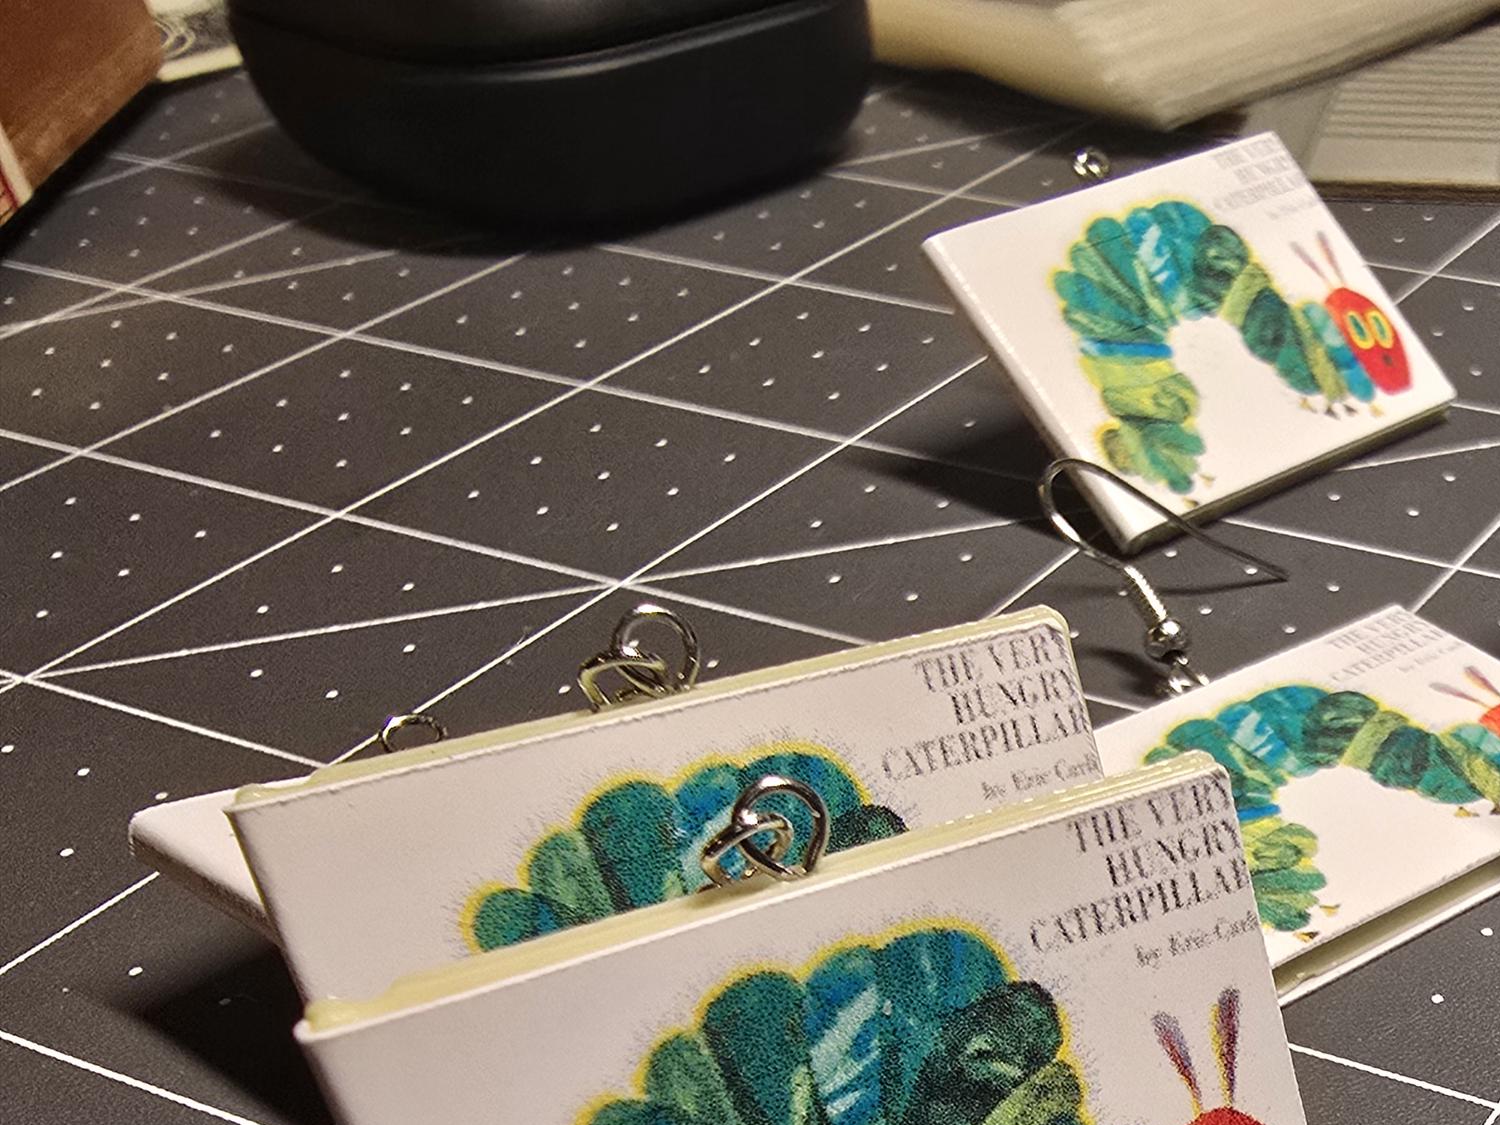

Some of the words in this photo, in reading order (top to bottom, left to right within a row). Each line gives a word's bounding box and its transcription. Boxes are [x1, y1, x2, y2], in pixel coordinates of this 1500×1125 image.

[914, 647, 983, 692] THE
[988, 628, 1069, 674] VERY
[1328, 629, 1365, 649] THE
[950, 669, 1078, 725] HUNGRY
[1066, 801, 1142, 853] THE
[1148, 776, 1231, 827] VERY
[1106, 820, 1240, 887] HUNGRY
